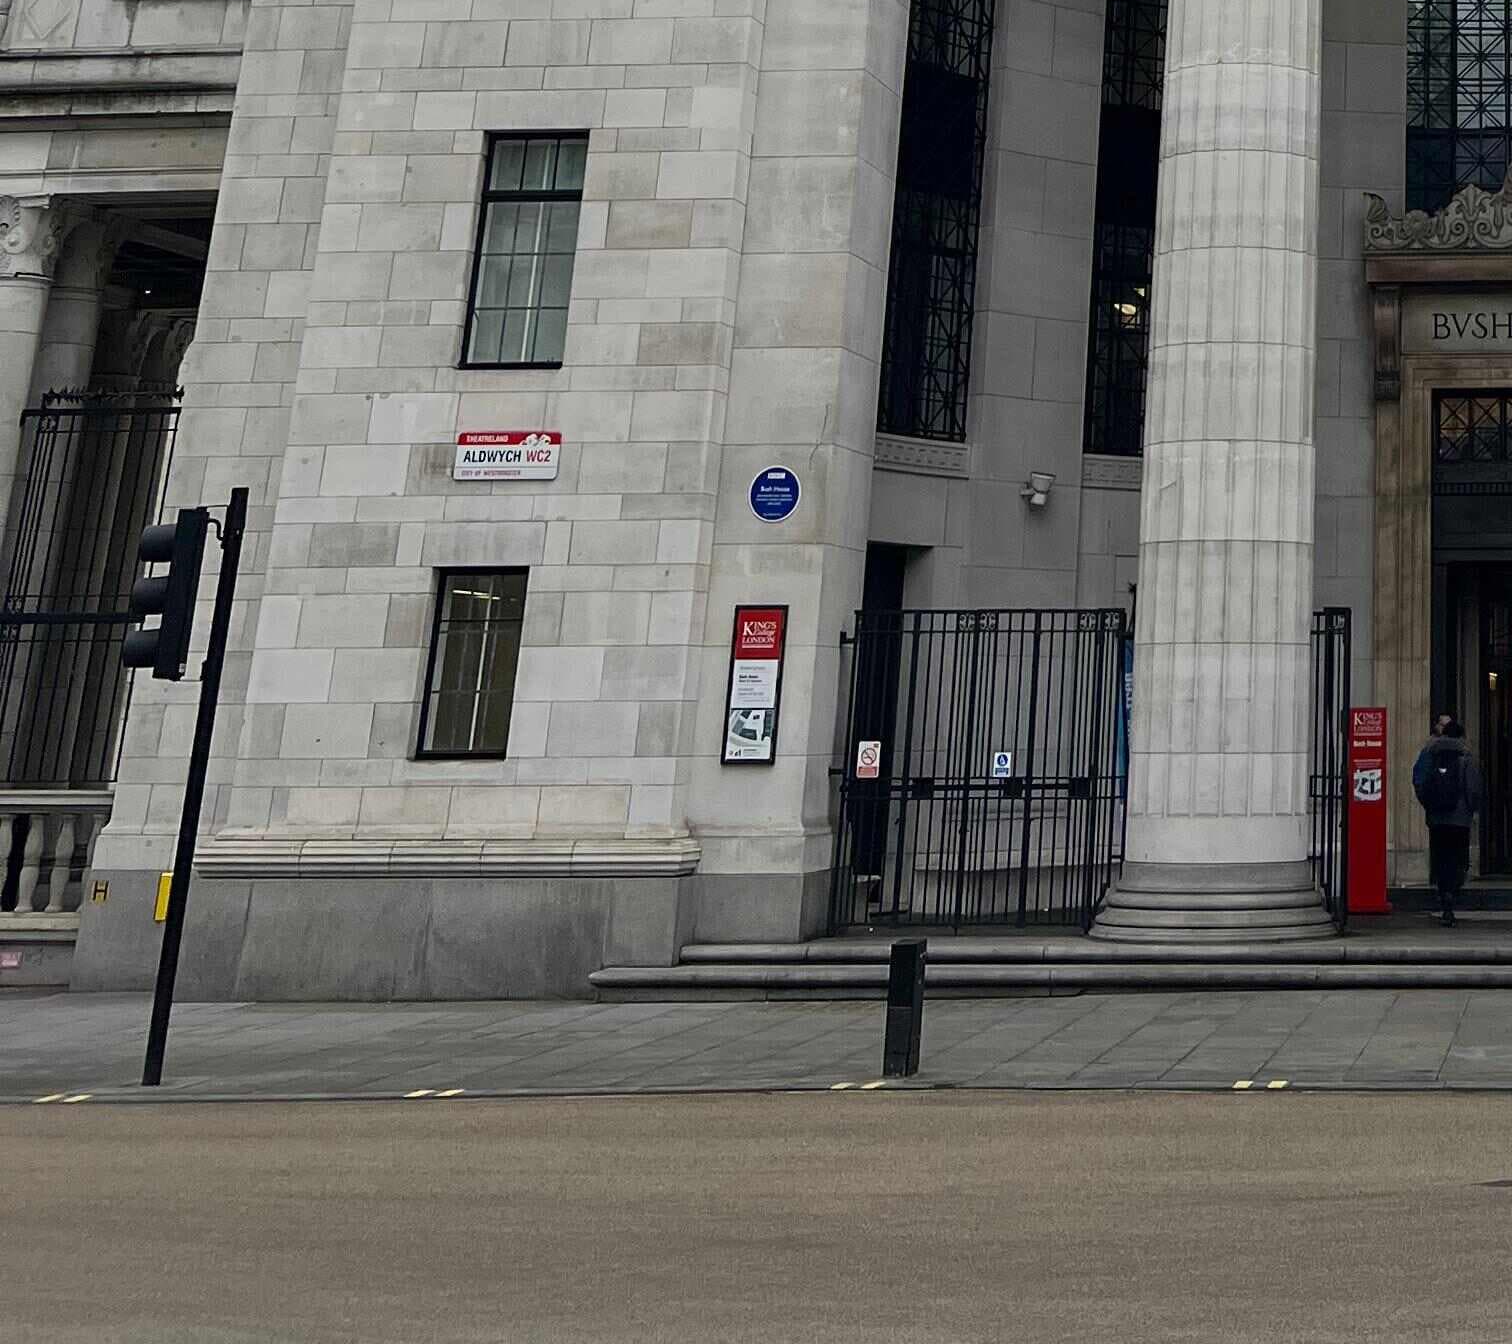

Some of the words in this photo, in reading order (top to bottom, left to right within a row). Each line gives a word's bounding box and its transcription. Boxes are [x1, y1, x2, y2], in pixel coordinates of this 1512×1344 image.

[1432, 312, 1512, 340] BVSH
[463, 450, 522, 463] ALDWYCH
[526, 450, 552, 463] WC2
[93, 880, 109, 902] H
